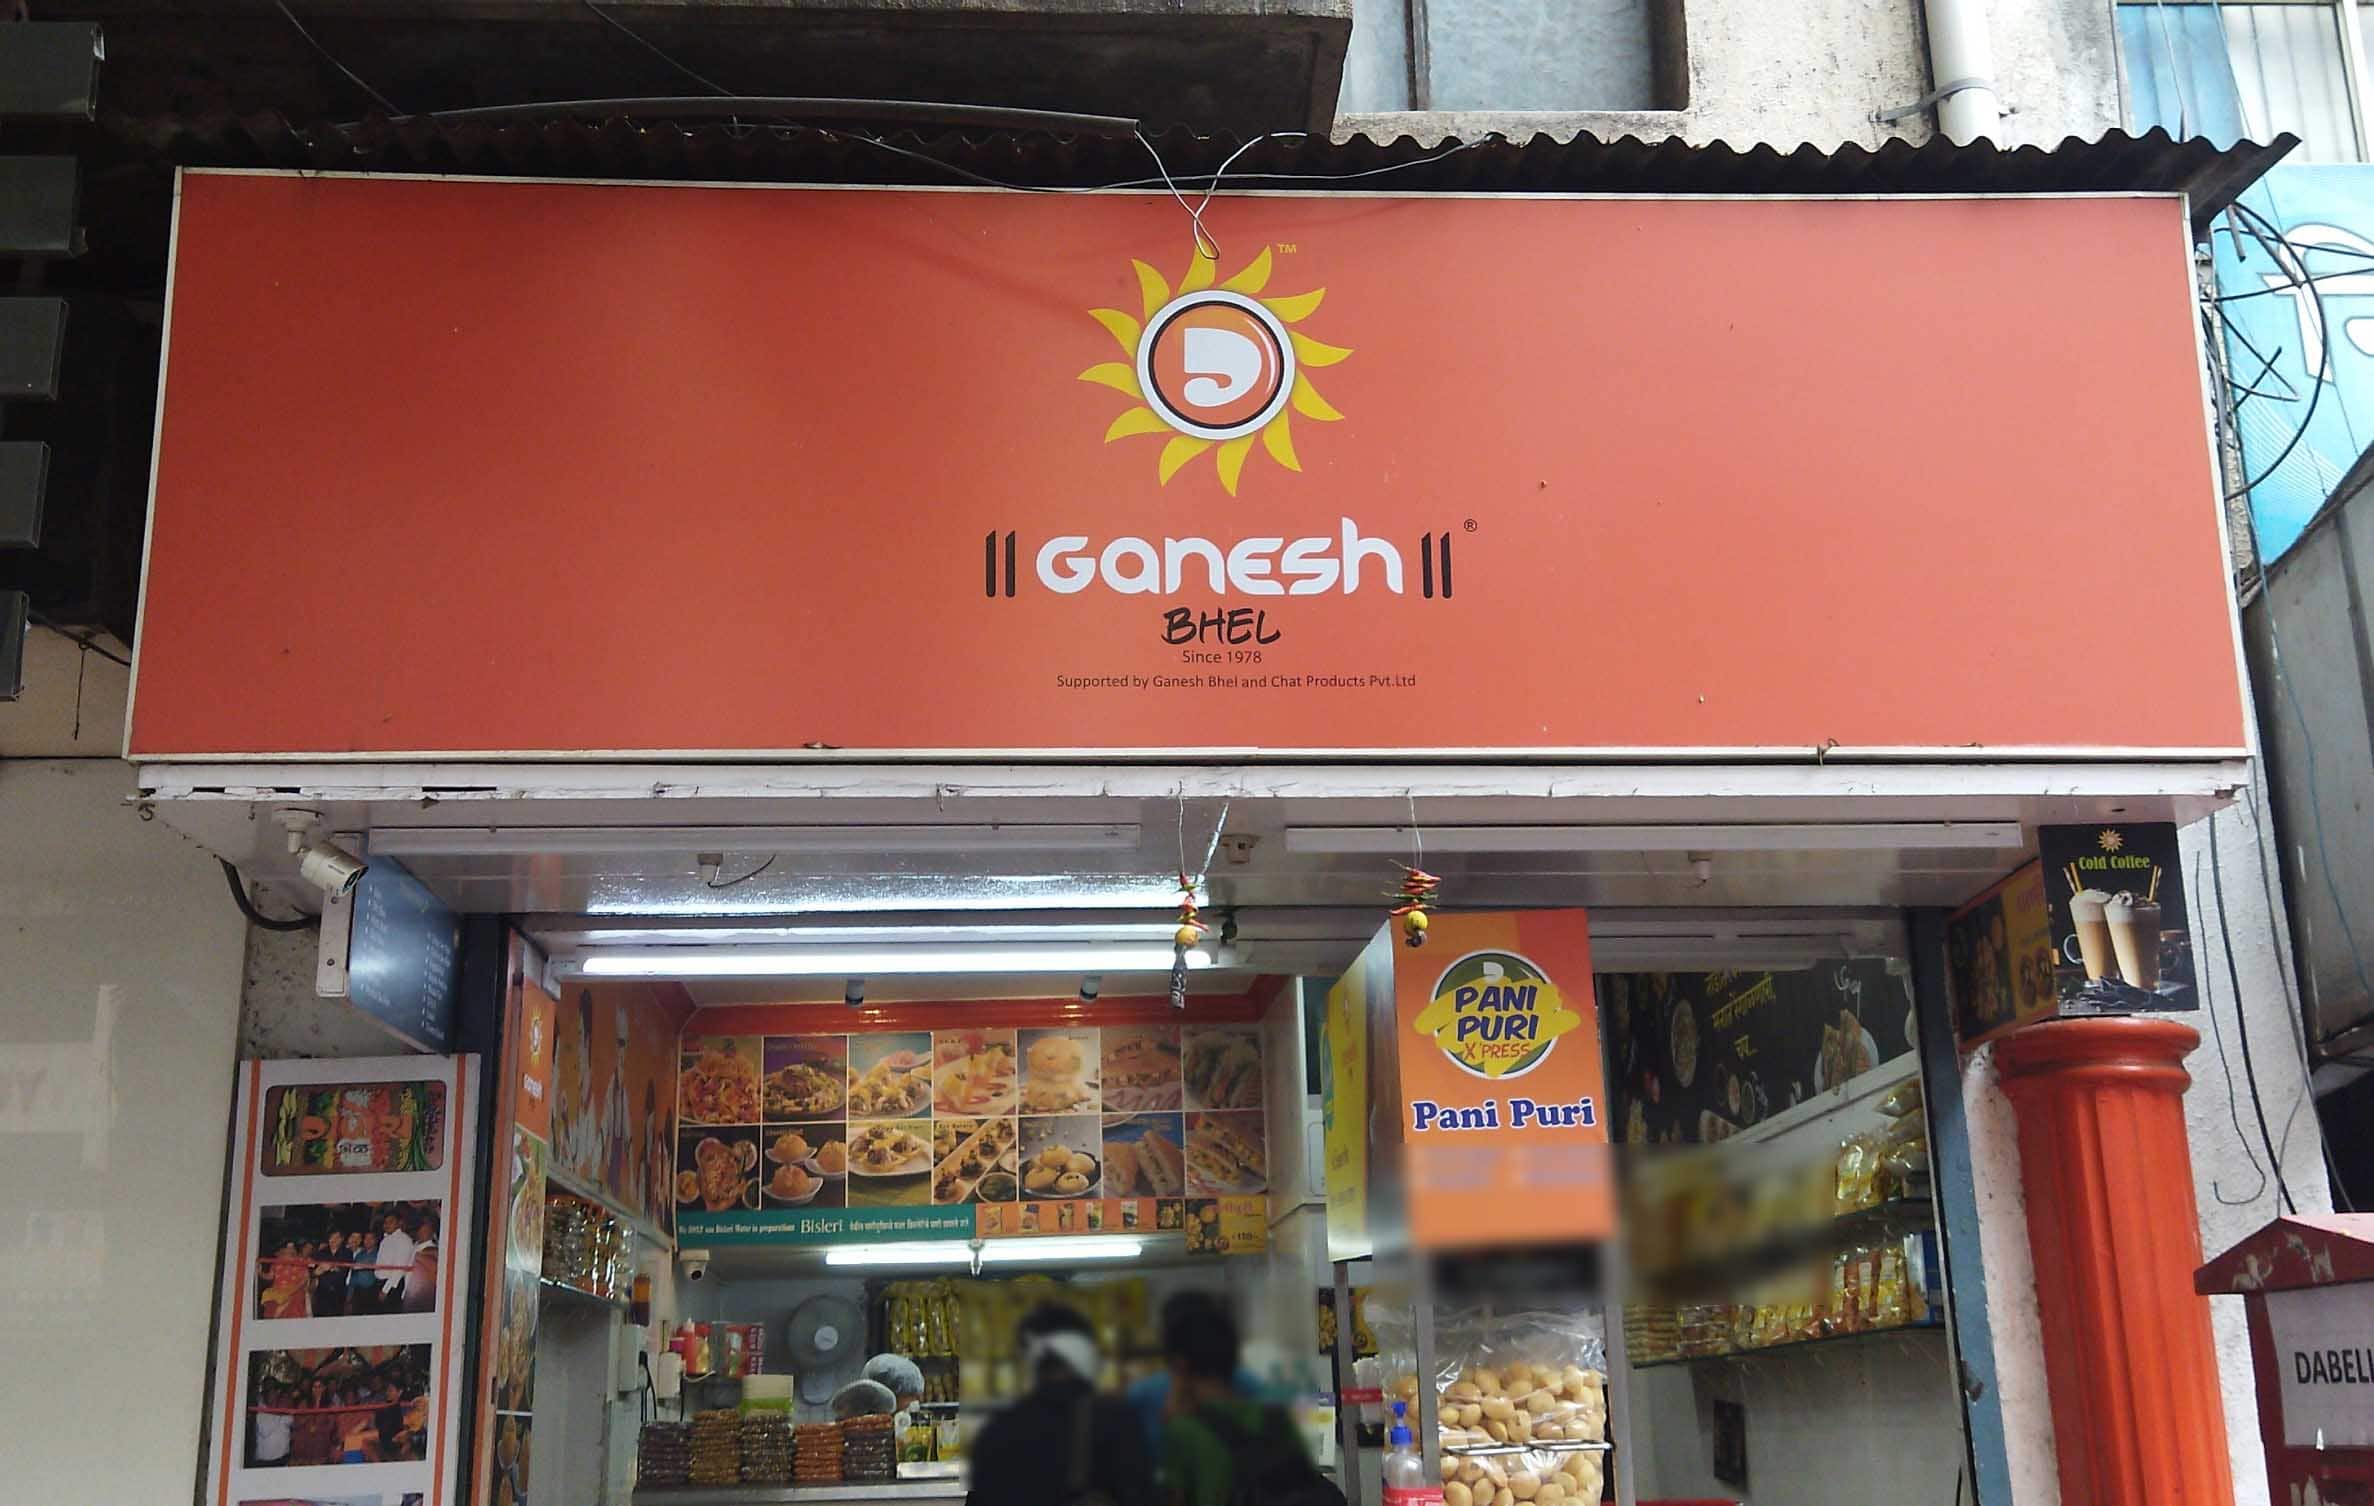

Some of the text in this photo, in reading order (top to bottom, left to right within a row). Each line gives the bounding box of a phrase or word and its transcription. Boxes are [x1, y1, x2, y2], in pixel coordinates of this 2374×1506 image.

[1160, 606, 1282, 645] BHEL
[1182, 649, 1262, 664] Since 1978
[1056, 673, 1417, 690] Supported by Ganesh Bhel and Chat Products Pvt.Ltd
[2079, 855, 2151, 870] Cold Coffee
[1455, 985, 1538, 1013] PANI
[1456, 1014, 1540, 1042] PURI
[1412, 1097, 1596, 1131] Pani Puri
[800, 1218, 844, 1234] Bisleri
